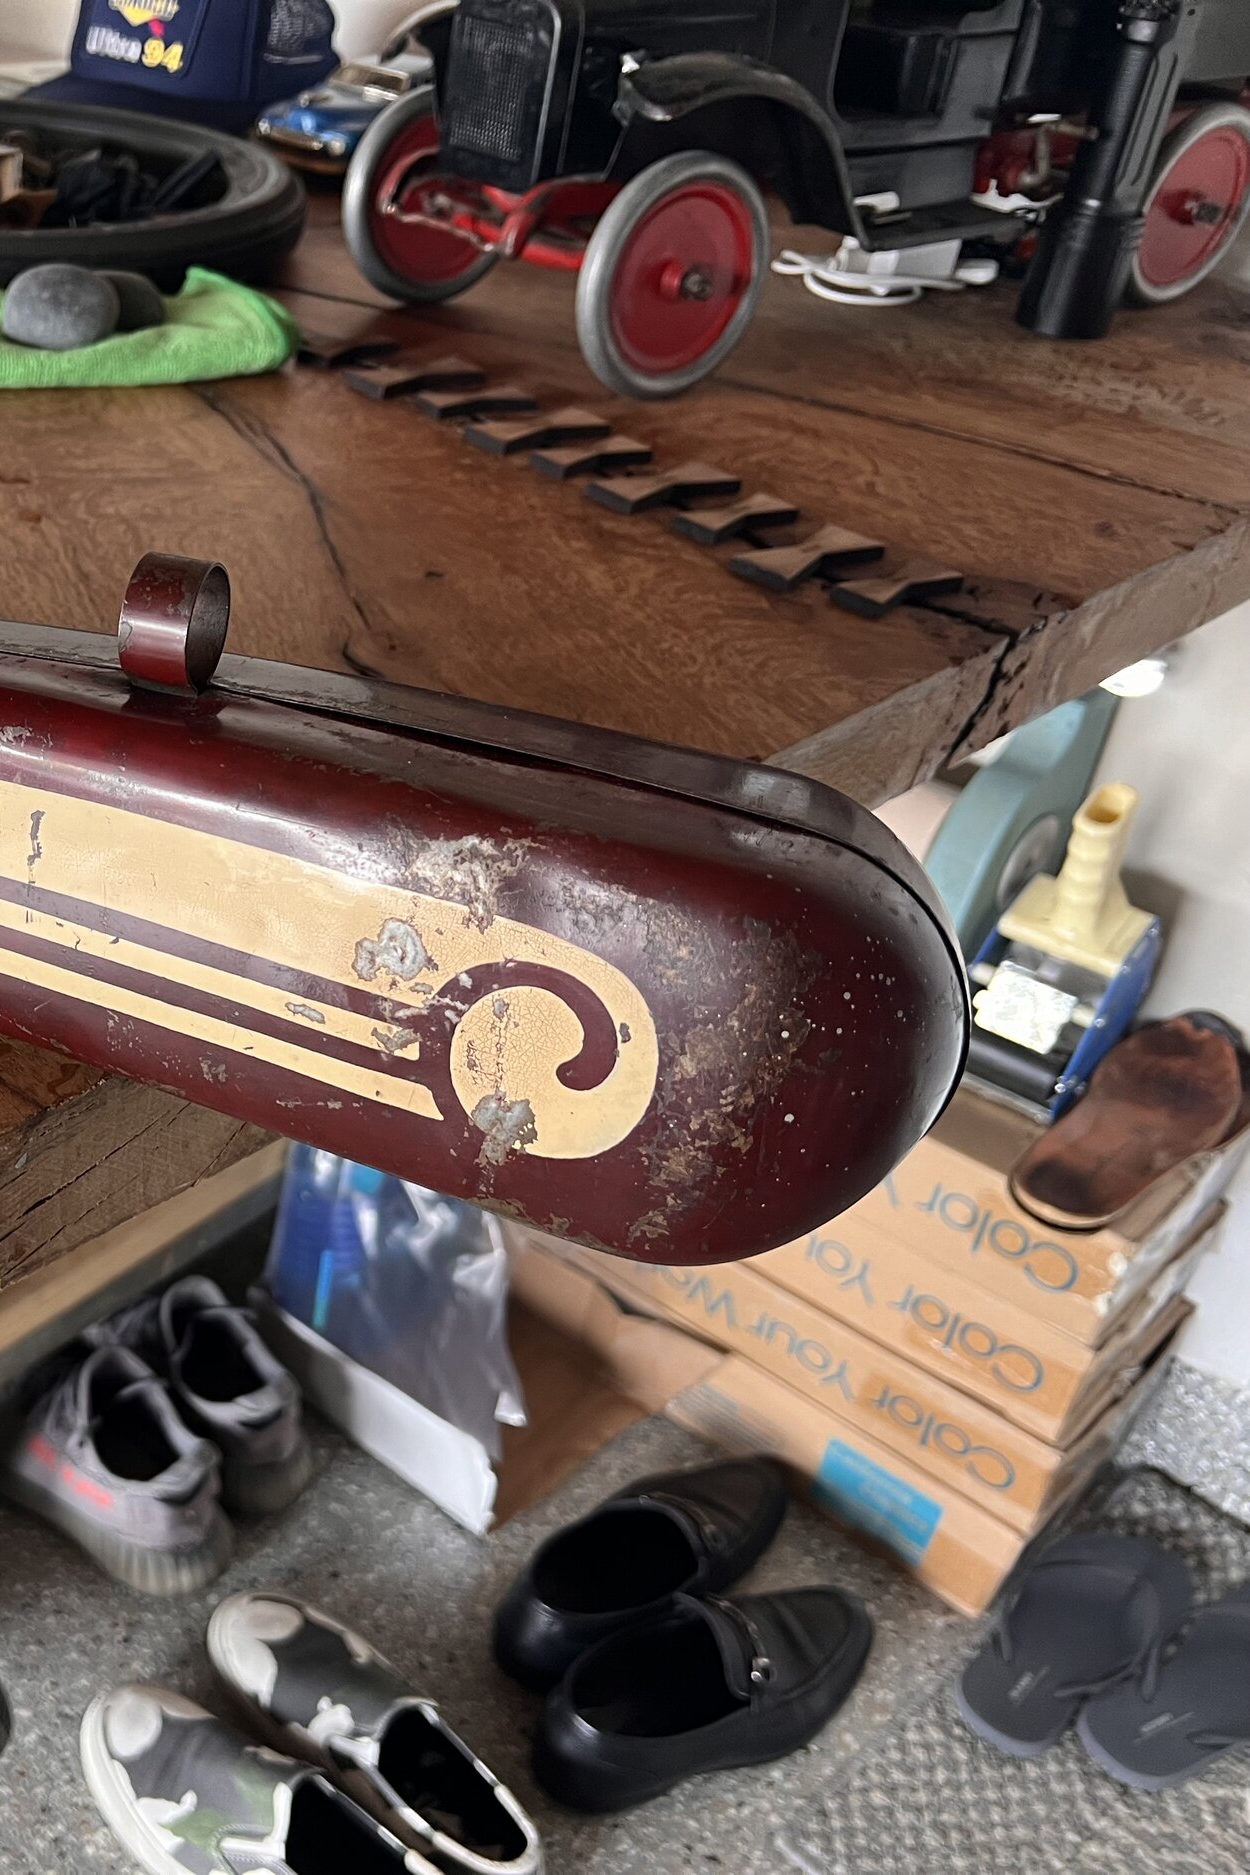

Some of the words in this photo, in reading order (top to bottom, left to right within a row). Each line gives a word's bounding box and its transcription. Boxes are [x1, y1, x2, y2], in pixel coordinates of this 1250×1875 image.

[141, 38, 184, 73] 94
[914, 1182, 1079, 1293] Color
[747, 1309, 857, 1402] Your
[888, 1284, 1044, 1394] Color
[869, 1384, 1016, 1491] Color
